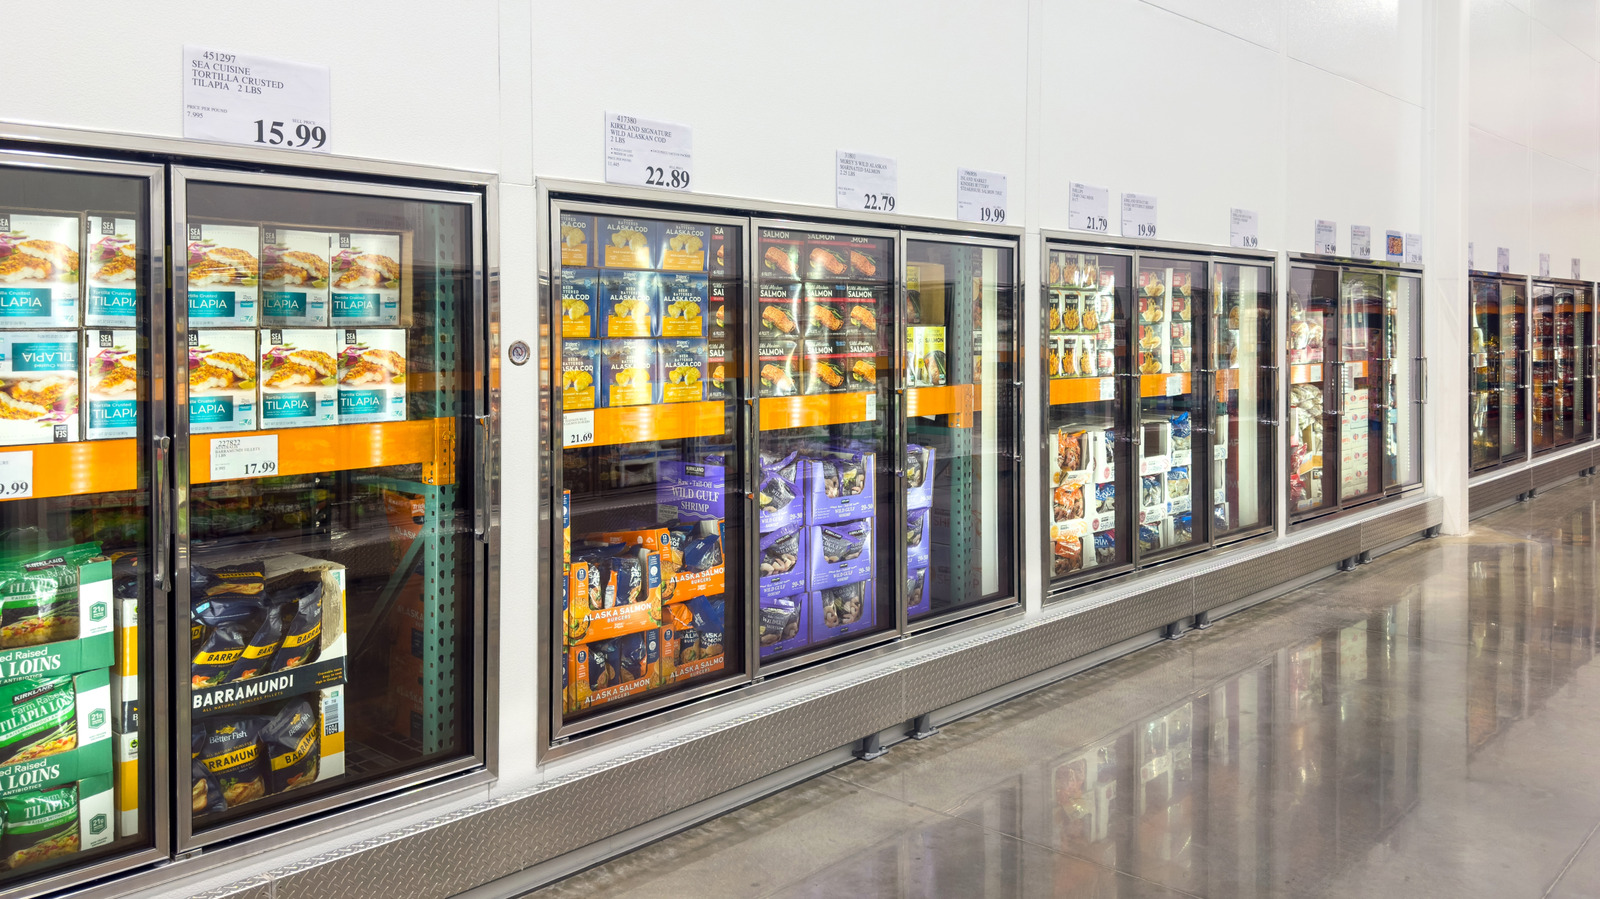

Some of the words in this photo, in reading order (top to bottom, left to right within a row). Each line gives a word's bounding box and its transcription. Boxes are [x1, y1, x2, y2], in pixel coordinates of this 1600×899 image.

[202, 51, 236, 63] 451297
[192, 60, 210, 69] SEA
[213, 62, 250, 75] CUISINE
[192, 69, 239, 83] TORTILLA
[242, 77, 284, 89] CRUSTED
[192, 78, 229, 90] TILAPIA
[245, 85, 262, 94] LBS
[617, 115, 637, 124] 417380
[254, 120, 326, 149] 15.99
[610, 122, 640, 133] KIRKLAND
[641, 128, 671, 137] SIGNATURE
[627, 132, 653, 141] ALASKAN
[646, 166, 690, 188] 22.89
[864, 194, 895, 211] 22.79
[981, 208, 1005, 223] 19.99
[103, 222, 114, 230] SEA
[1087, 216, 1107, 231] 21.79
[190, 228, 200, 236] SEA
[763, 230, 790, 239] SALMON
[1138, 224, 1156, 237] 19.99
[334, 301, 373, 309] TILAPIA
[22, 352, 74, 362] TILAPIA
[759, 348, 784, 356] SALMON
[266, 400, 309, 410] TILAPIA
[341, 397, 380, 407] TILAPIA
[571, 432, 592, 443] 21.69
[245, 462, 275, 474] 17.99
[672, 487, 694, 499] WILD
[696, 489, 719, 502] GULF
[681, 501, 709, 512] SHRIMP
[26, 558, 63, 568] KIRKLAND
[670, 573, 700, 583] ALASKA
[583, 610, 618, 622] ALASKA
[620, 603, 652, 614] SALMON
[607, 614, 631, 623] BURGERS
[15, 647, 48, 660] Raised
[9, 654, 61, 677] LOINS
[670, 664, 699, 678] ALASKA
[701, 657, 723, 668] SALMO
[4, 673, 42, 684] ANTIBIOTICS
[14, 684, 53, 701] KIRKLAND
[193, 674, 294, 709] BARRAMUNDI
[585, 688, 617, 704] ALASKA
[619, 679, 650, 693] SALMON
[11, 703, 35, 716] Farm
[214, 702, 237, 711] NATURAL
[239, 696, 263, 705] SKINLESS
[0, 705, 48, 732] TILAPIA
[288, 722, 302, 737] Better
[301, 713, 311, 727] Fish
[210, 734, 231, 744] Better
[232, 730, 248, 740] Fish
[15, 758, 47, 772] Raised
[8, 764, 60, 790] LOINS
[3, 784, 41, 796] ANTIBIOTICS
